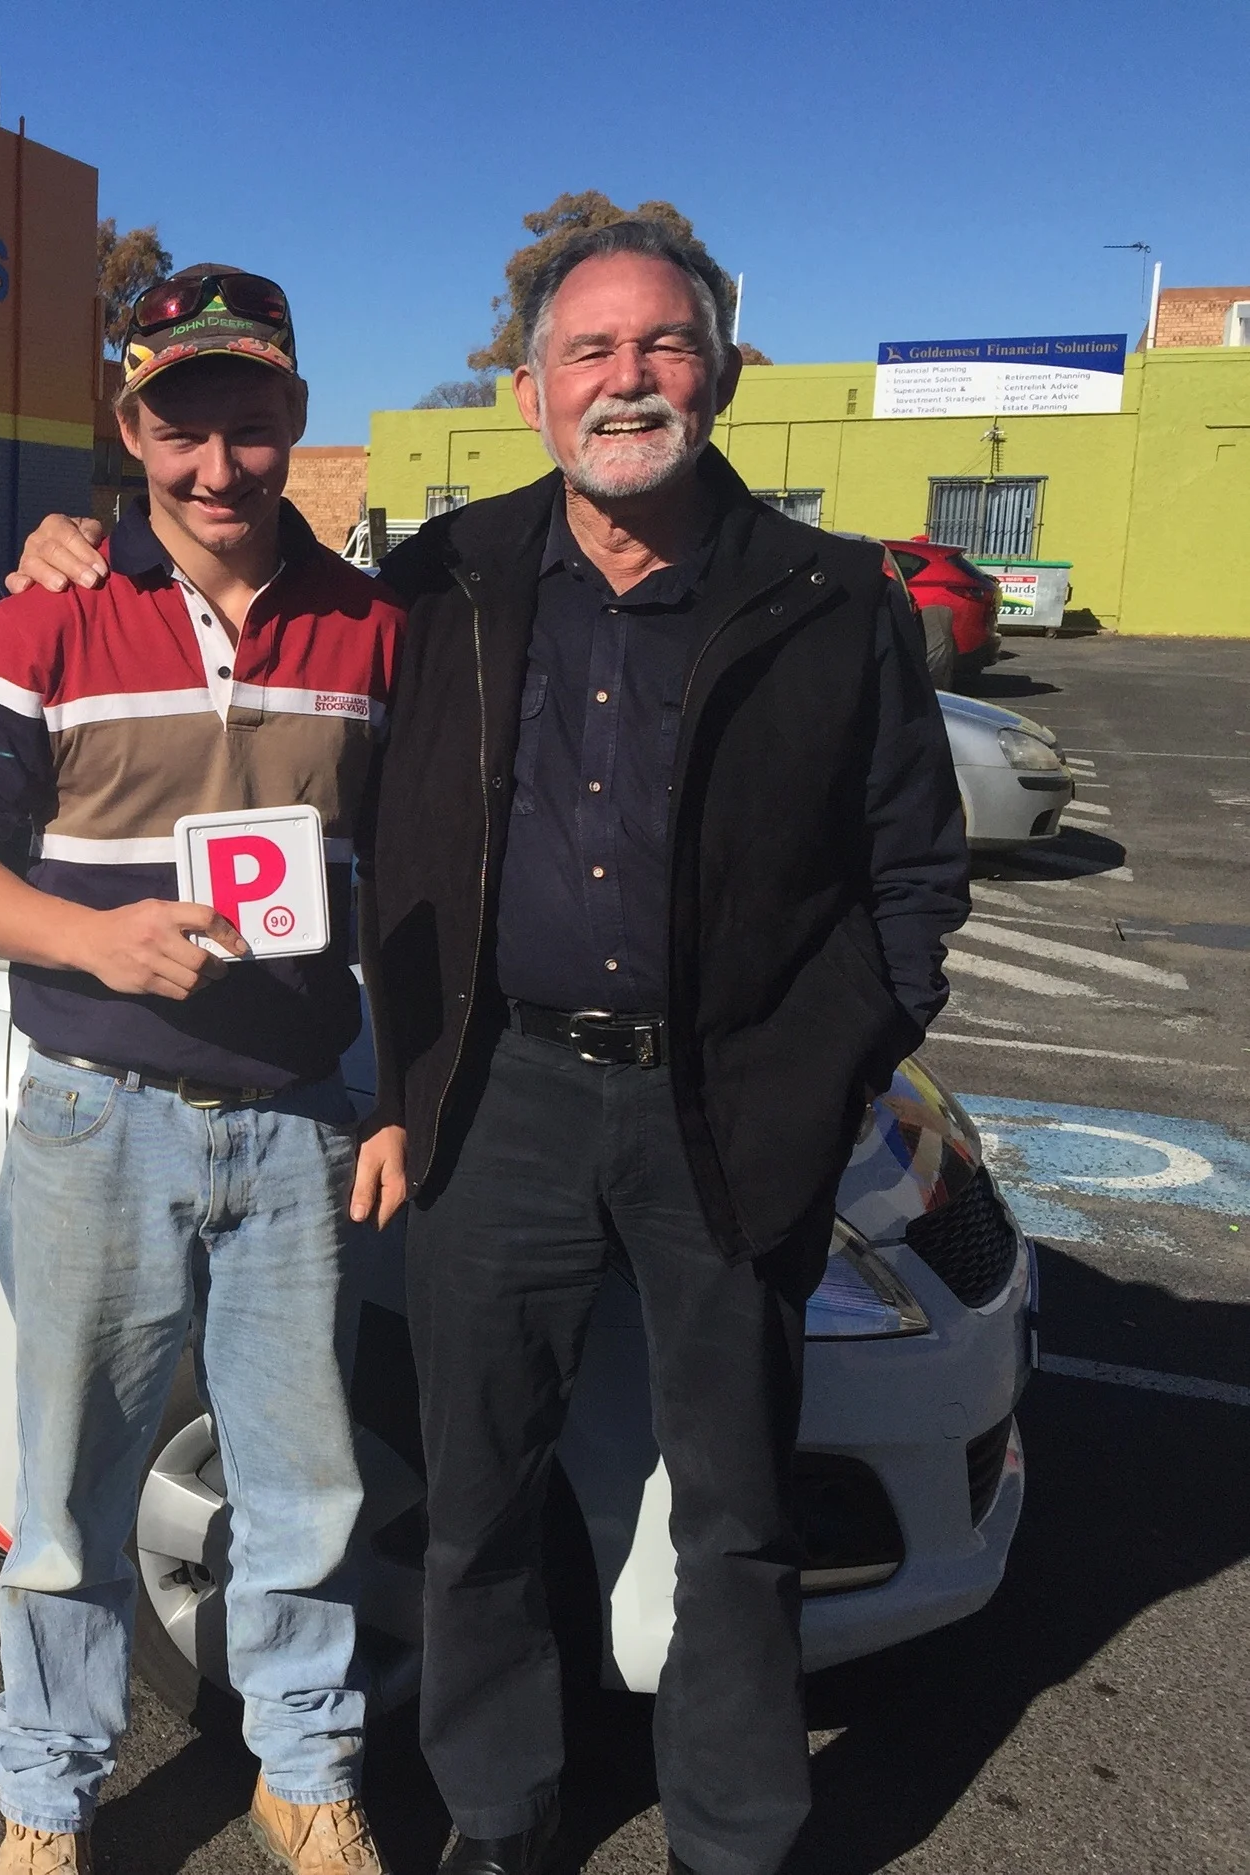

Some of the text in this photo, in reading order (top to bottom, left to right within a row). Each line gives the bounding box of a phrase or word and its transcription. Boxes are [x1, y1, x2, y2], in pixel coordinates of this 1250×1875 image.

[168, 316, 254, 338] JOHN DEERE
[909, 341, 1118, 359] Goldenwest Financial Solutions
[932, 366, 967, 374] Planning
[1055, 372, 1090, 380] Planning
[893, 386, 957, 395] Superannuation
[1004, 383, 1046, 391] Centrelink
[945, 395, 986, 403] Strategies
[1003, 392, 1079, 402] Aged Care Advice
[917, 406, 947, 414] Trading
[1032, 403, 1067, 412] Planning
[207, 835, 287, 935] P
[270, 915, 288, 928] 90
